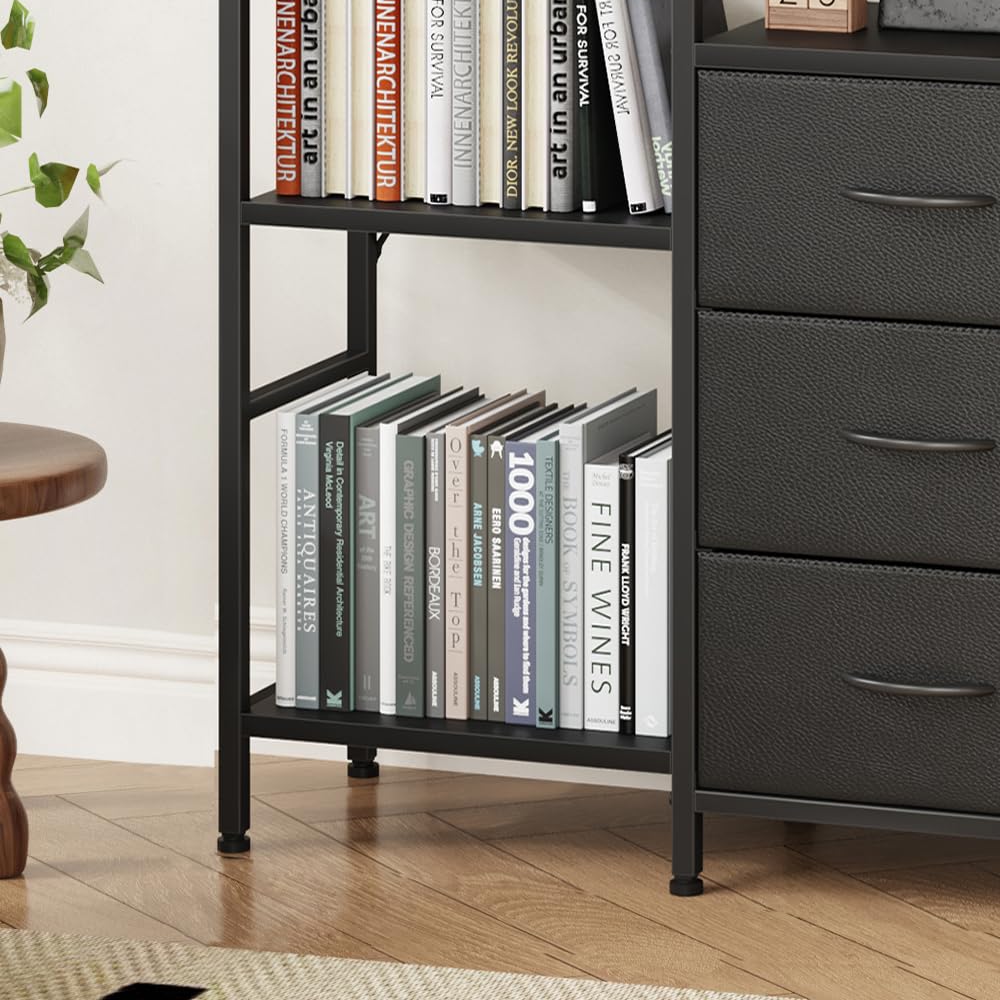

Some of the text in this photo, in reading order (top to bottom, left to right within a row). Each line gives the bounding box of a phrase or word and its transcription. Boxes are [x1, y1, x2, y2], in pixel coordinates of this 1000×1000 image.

[576, 4, 588, 36] FOR
[302, 59, 319, 89] an
[430, 32, 445, 100] SURVIVAL
[506, 67, 518, 111] LOOK
[552, 72, 568, 103] an
[577, 39, 589, 108] SURVIVAL
[300, 97, 319, 122] in
[506, 114, 518, 151] NEW
[549, 111, 568, 134] in
[302, 128, 319, 165] art
[506, 155, 518, 198] DIOR.
[551, 143, 568, 180] art
[280, 428, 288, 475] FORMULA
[323, 440, 334, 509] Virginia McLeod
[280, 482, 288, 518] WORLD
[359, 493, 376, 540] ART
[508, 451, 535, 536] 1000
[544, 455, 554, 545] TEXTILE DESIGNERS
[280, 519, 288, 575] CHAMPIONS
[334, 440, 345, 638] Detail in Contemporary Residential Architecture
[473, 502, 483, 587] ARNE JACOBSEN
[491, 507, 502, 590] EERO SAARINEN
[563, 496, 578, 557] BOOK
[591, 501, 612, 573] FINE
[300, 488, 317, 634] ANTIQUAIRES
[402, 458, 415, 663] GRAPHIC DESIGN REFERENCED
[428, 546, 440, 620] BORDEAUX
[621, 543, 630, 647] FRANK LLOYD WRIGHT
[563, 579, 578, 687] SYMBOLS
[591, 589, 612, 695] WINES
